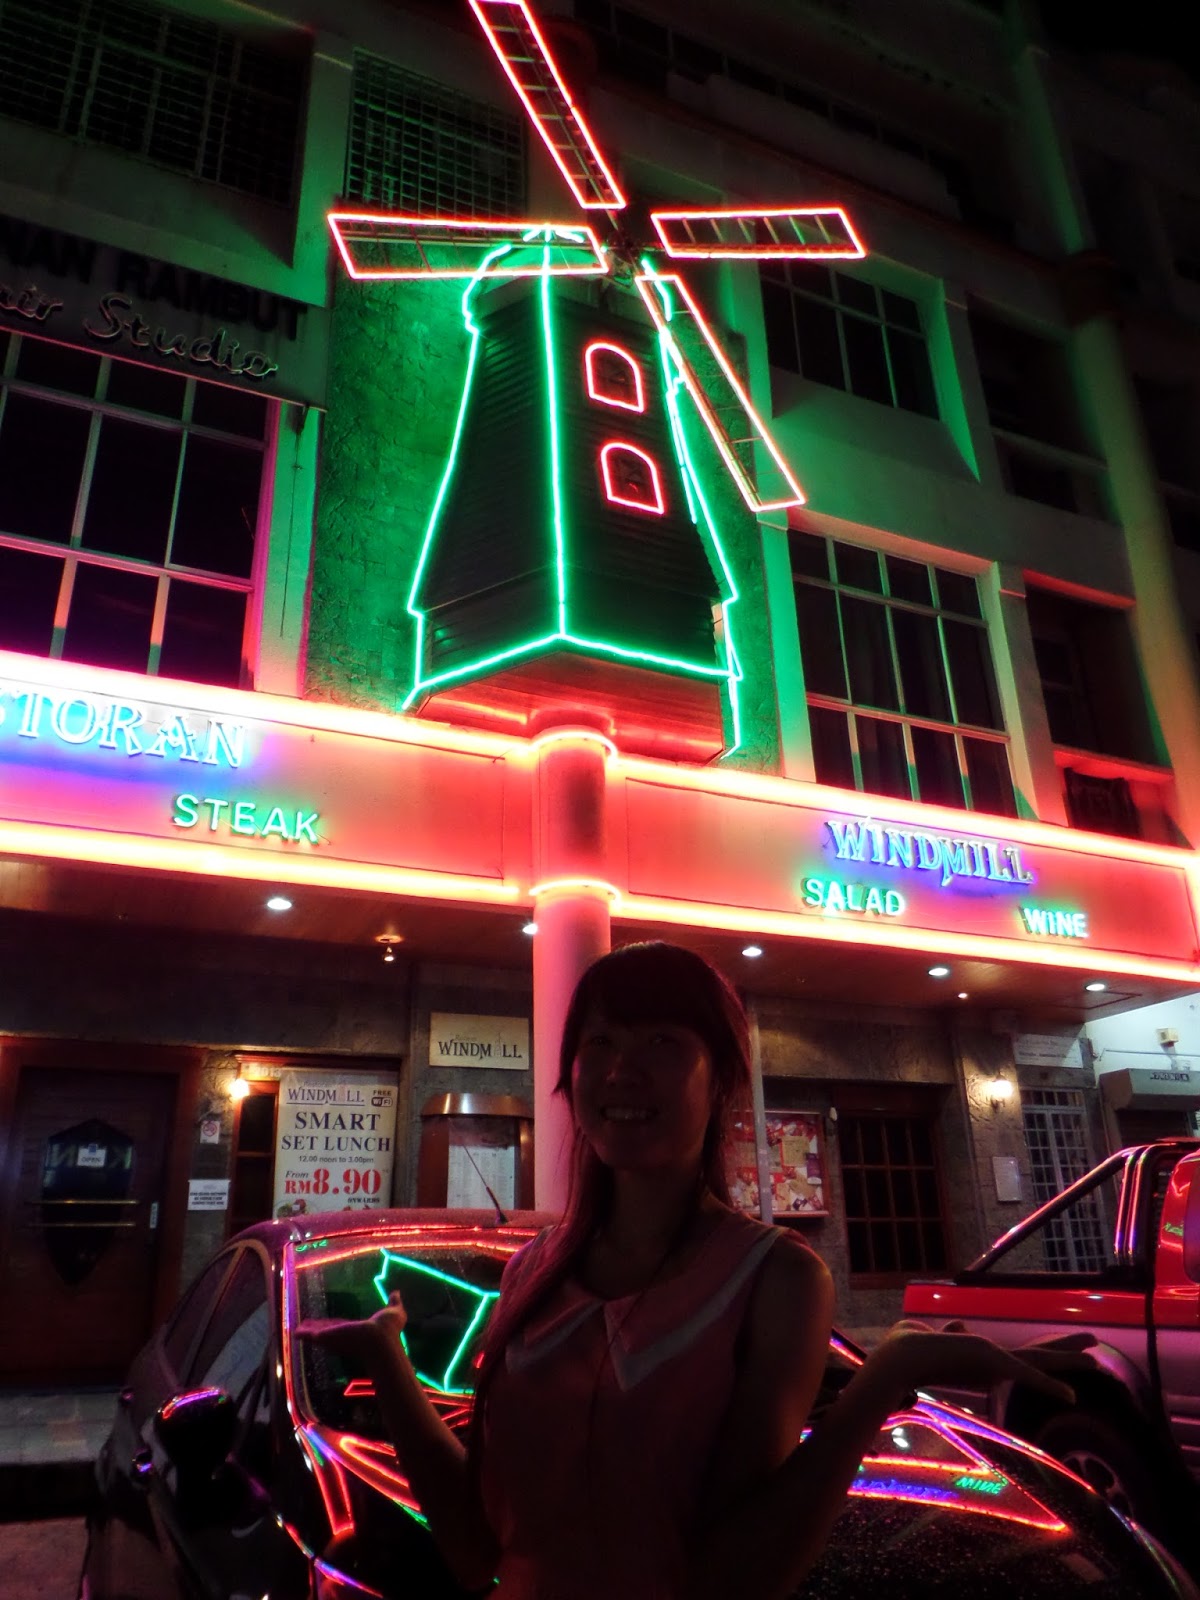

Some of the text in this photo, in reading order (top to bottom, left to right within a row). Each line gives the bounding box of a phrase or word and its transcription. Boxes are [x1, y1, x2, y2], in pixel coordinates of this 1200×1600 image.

[116, 252, 308, 341] RAMBUT
[83, 291, 279, 378] Studio
[0, 690, 250, 768] TORAN
[173, 793, 322, 845] STEAK
[826, 817, 1034, 886] WINDMILL
[803, 878, 906, 918] SALAD
[1022, 907, 1089, 938] WINE
[288, 1086, 392, 1104] WINDMLL FREE
[294, 1111, 381, 1132] SMART
[281, 1135, 391, 1152] SET LUNCH
[299, 1155, 318, 1163] 12.00
[319, 1156, 338, 1164] noon
[285, 1170, 309, 1180] From
